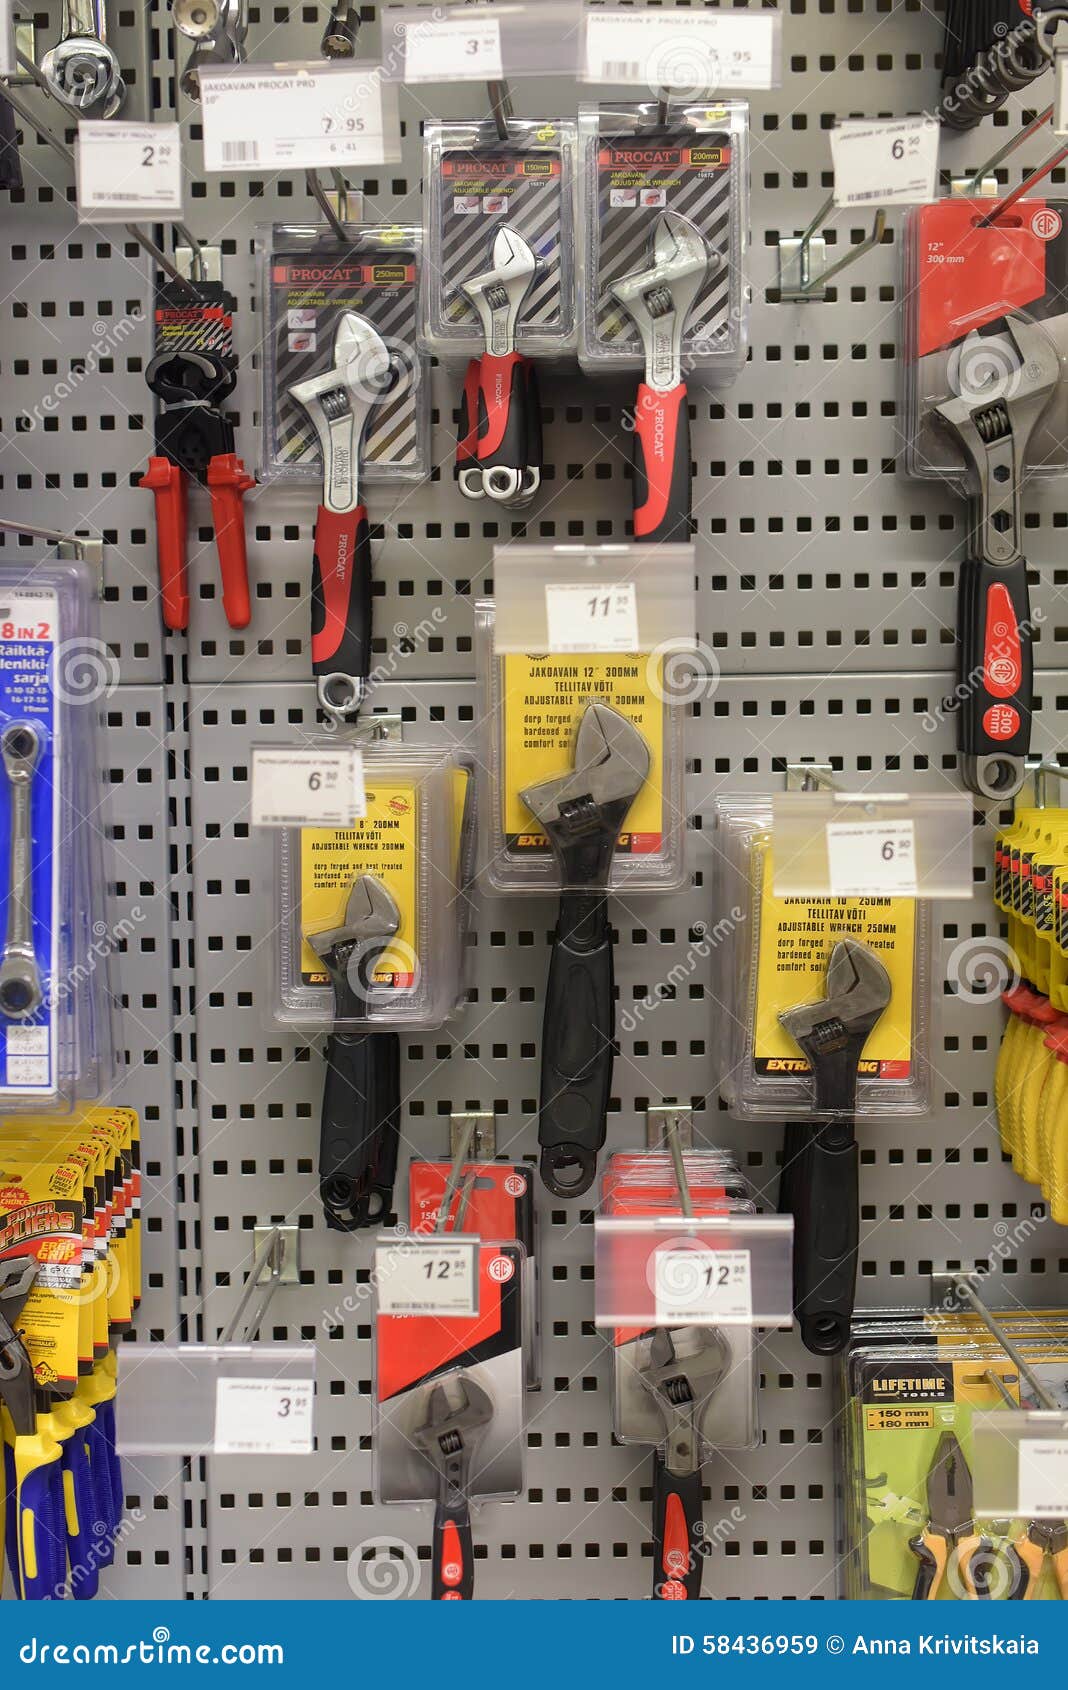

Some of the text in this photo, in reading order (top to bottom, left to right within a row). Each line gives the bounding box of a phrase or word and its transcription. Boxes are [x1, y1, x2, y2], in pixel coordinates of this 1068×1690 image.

[465, 39, 479, 55] 3
[892, 139, 904, 159] 6
[141, 145, 155, 167] 2
[615, 151, 719, 162] PROCAT 200mm
[456, 163, 508, 173] PROCAT
[927, 243, 944, 251] 12"
[927, 255, 965, 264] 300 mm
[291, 269, 403, 281] PROCAT 250mm
[654, 409, 665, 456] PROCAT
[336, 534, 348, 580] PROCAT
[587, 596, 611, 617] 11
[2, 622, 50, 639] 8 IN 2
[529, 667, 578, 677] JAKOAVAIN
[605, 667, 638, 677] 300MM
[14, 672, 49, 686] sarja
[555, 681, 591, 692] TELLITAV
[524, 695, 573, 705] ADJUSTABLE
[615, 695, 645, 705] 300MM
[546, 714, 571, 724] forged
[990, 709, 1001, 734] mm
[1000, 710, 1012, 734] 300
[524, 727, 560, 736] hardened
[524, 740, 554, 748] comfort
[308, 772, 322, 791] 6
[374, 820, 400, 829] 200MM
[335, 831, 364, 840] TELLITAV
[382, 843, 405, 851] 200MM
[882, 840, 894, 861] 6
[330, 863, 349, 871] forged
[808, 908, 844, 919] TELLITAV
[777, 922, 897, 934] ADJUSTABLE WRENCH 250MM
[799, 938, 823, 948] forged
[777, 950, 811, 959] hardened
[777, 963, 806, 971] comfort
[55, 1168, 76, 1179] MORE
[7, 1201, 55, 1225] POWER
[0, 1212, 74, 1249] PLIERS
[41, 1241, 75, 1250] ERGO
[37, 1250, 76, 1261] GRIP
[423, 1261, 450, 1279] 12
[703, 1265, 730, 1286] 12
[873, 1378, 945, 1391] LIFETIME
[277, 1397, 291, 1417] 3
[879, 1410, 902, 1418] 150
[879, 1420, 902, 1428] 180
